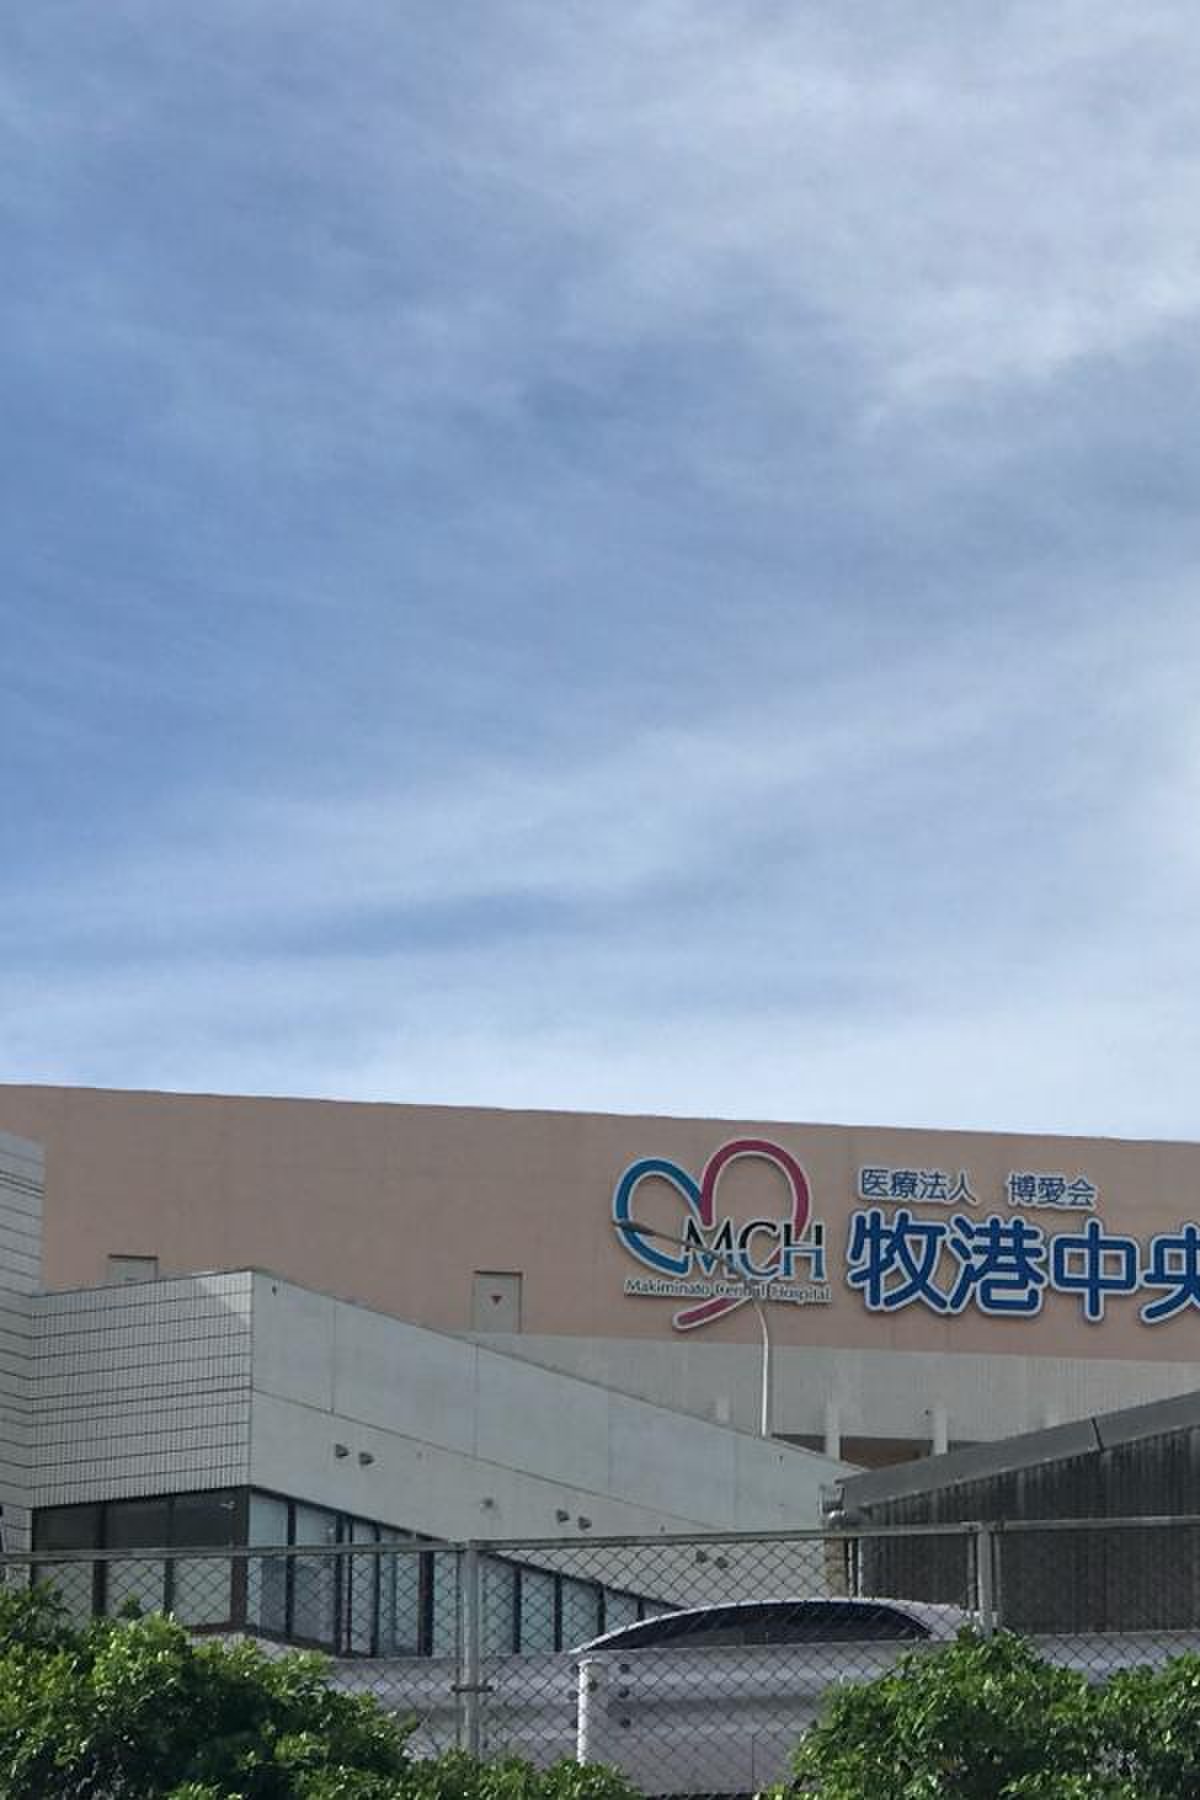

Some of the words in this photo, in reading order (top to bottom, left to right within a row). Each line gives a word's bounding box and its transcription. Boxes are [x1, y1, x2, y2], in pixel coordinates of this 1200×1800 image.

[861, 1168, 977, 1202] 医療法人
[1007, 1173, 1096, 1207] 博愛会
[684, 1215, 825, 1280] MCH
[625, 1279, 710, 1296] Makiminato
[769, 1283, 831, 1304] Hospital
